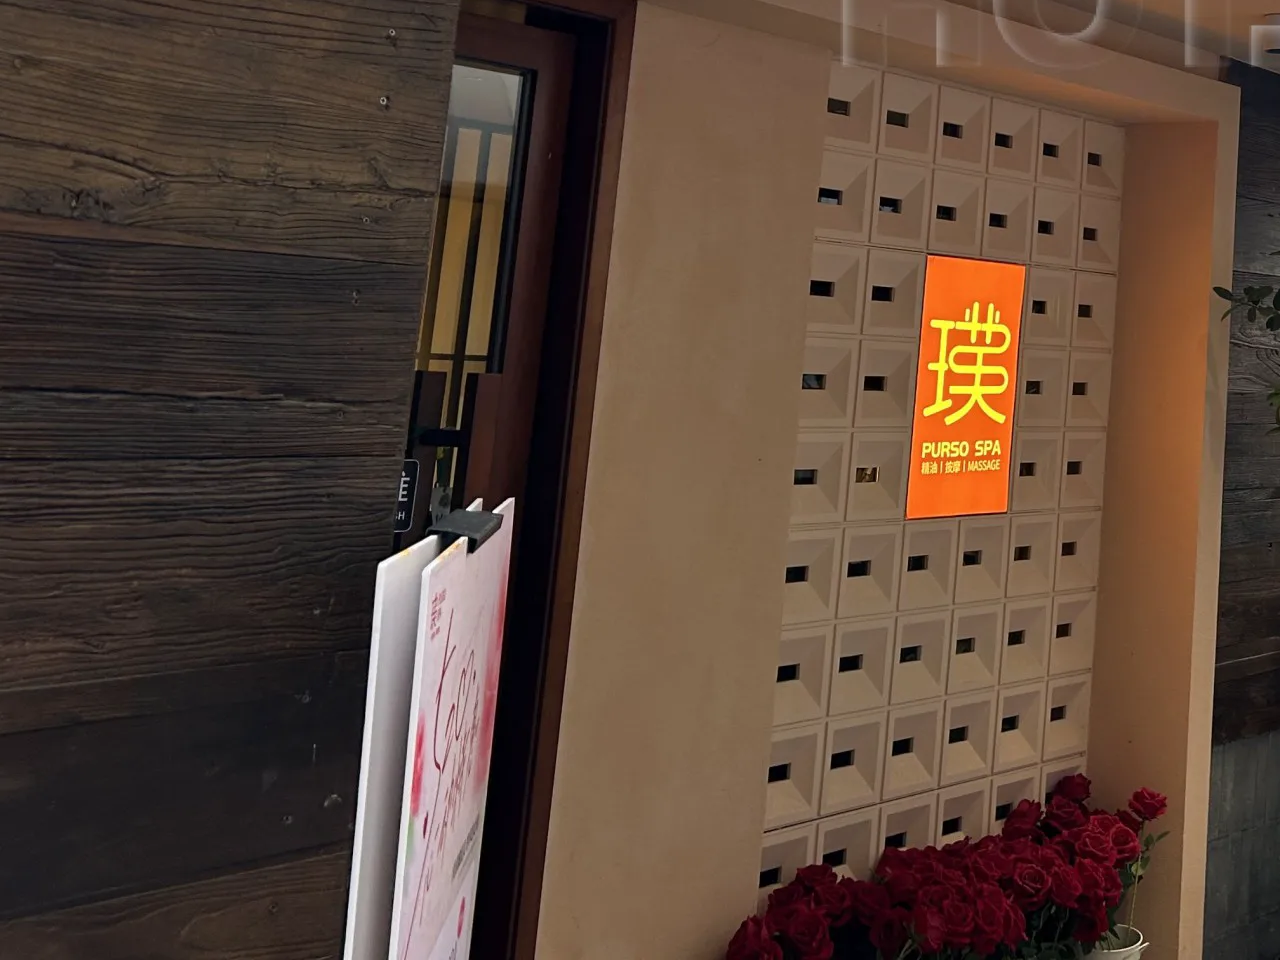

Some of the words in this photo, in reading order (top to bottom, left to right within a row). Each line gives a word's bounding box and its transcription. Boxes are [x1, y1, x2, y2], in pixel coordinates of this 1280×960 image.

[921, 441, 970, 459] PURSO
[974, 439, 1001, 457] SPA
[921, 461, 938, 475] 精油
[945, 461, 961, 474] 按摩
[967, 459, 1001, 473] MASSAGE
